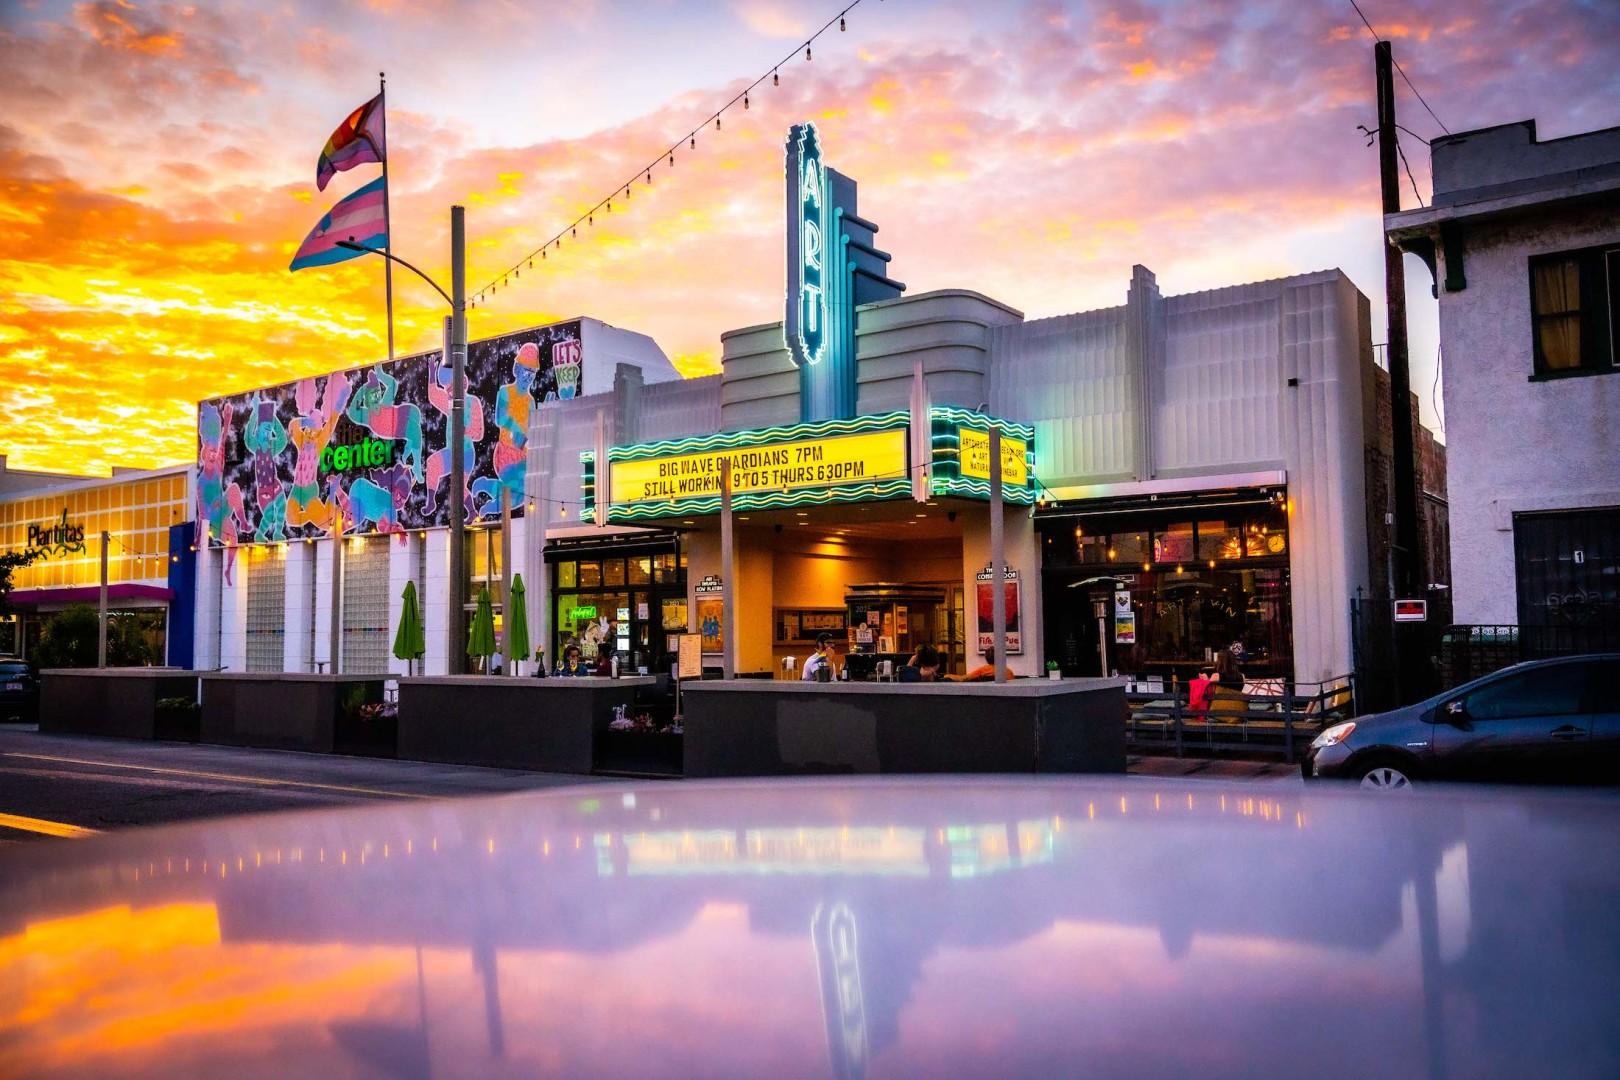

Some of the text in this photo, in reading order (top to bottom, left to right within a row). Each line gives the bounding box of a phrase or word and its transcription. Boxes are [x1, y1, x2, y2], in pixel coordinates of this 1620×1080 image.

[804, 158, 822, 333] ART
[556, 365, 579, 384] KEEP
[320, 437, 395, 473] center
[659, 462, 678, 477] BIG
[681, 458, 713, 474] WAVE
[795, 446, 823, 463] 7PM
[644, 480, 676, 496] STILL
[679, 476, 724, 493] WORKIN
[734, 473, 740, 487] 9
[742, 472, 758, 488] TO
[761, 471, 768, 485] 5
[772, 466, 814, 484] THURS
